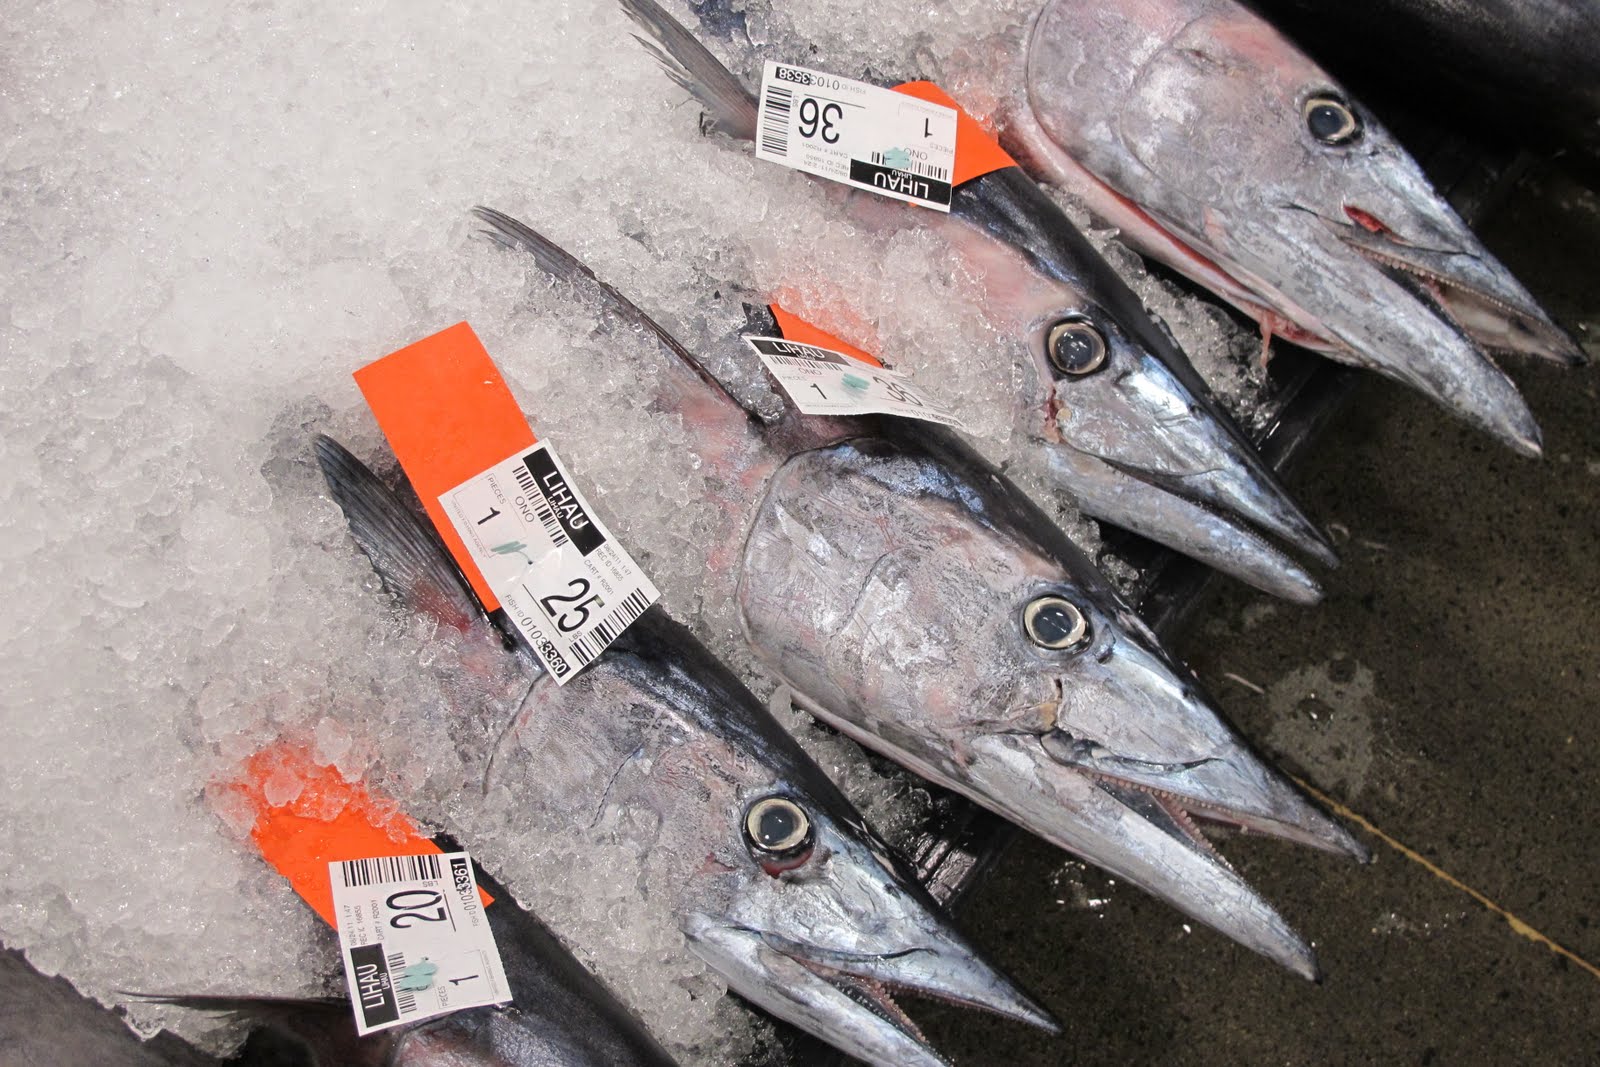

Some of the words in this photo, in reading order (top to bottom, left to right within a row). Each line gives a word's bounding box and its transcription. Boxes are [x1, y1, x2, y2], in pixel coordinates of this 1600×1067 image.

[799, 98, 842, 144] 36
[924, 117, 933, 138] 1
[828, 148, 848, 159] CART
[929, 142, 953, 154] PIECES
[891, 169, 912, 180] LIHAU
[874, 172, 928, 199] LIHAU
[772, 341, 826, 359] LIHAU
[810, 383, 827, 400] 1
[488, 477, 505, 505] PIECES
[542, 470, 589, 530] LIHAU
[477, 507, 501, 526] 1
[515, 496, 535, 523] ONO
[548, 496, 564, 519] LIHAU
[582, 558, 599, 576] CART
[594, 547, 608, 561] REC
[603, 559, 612, 568] ID
[540, 578, 605, 632] 25
[504, 593, 519, 611] FISH
[515, 609, 525, 618] ID
[521, 617, 567, 674] 01033360
[567, 629, 583, 644] LBS
[422, 879, 438, 887] LBS
[386, 890, 447, 928] 20
[359, 933, 368, 945] REC
[374, 925, 384, 940] CART
[357, 963, 385, 1009] LIHAU
[379, 972, 391, 989] LIHAU
[449, 975, 479, 986] 1
[437, 985, 449, 1006] PIECES
